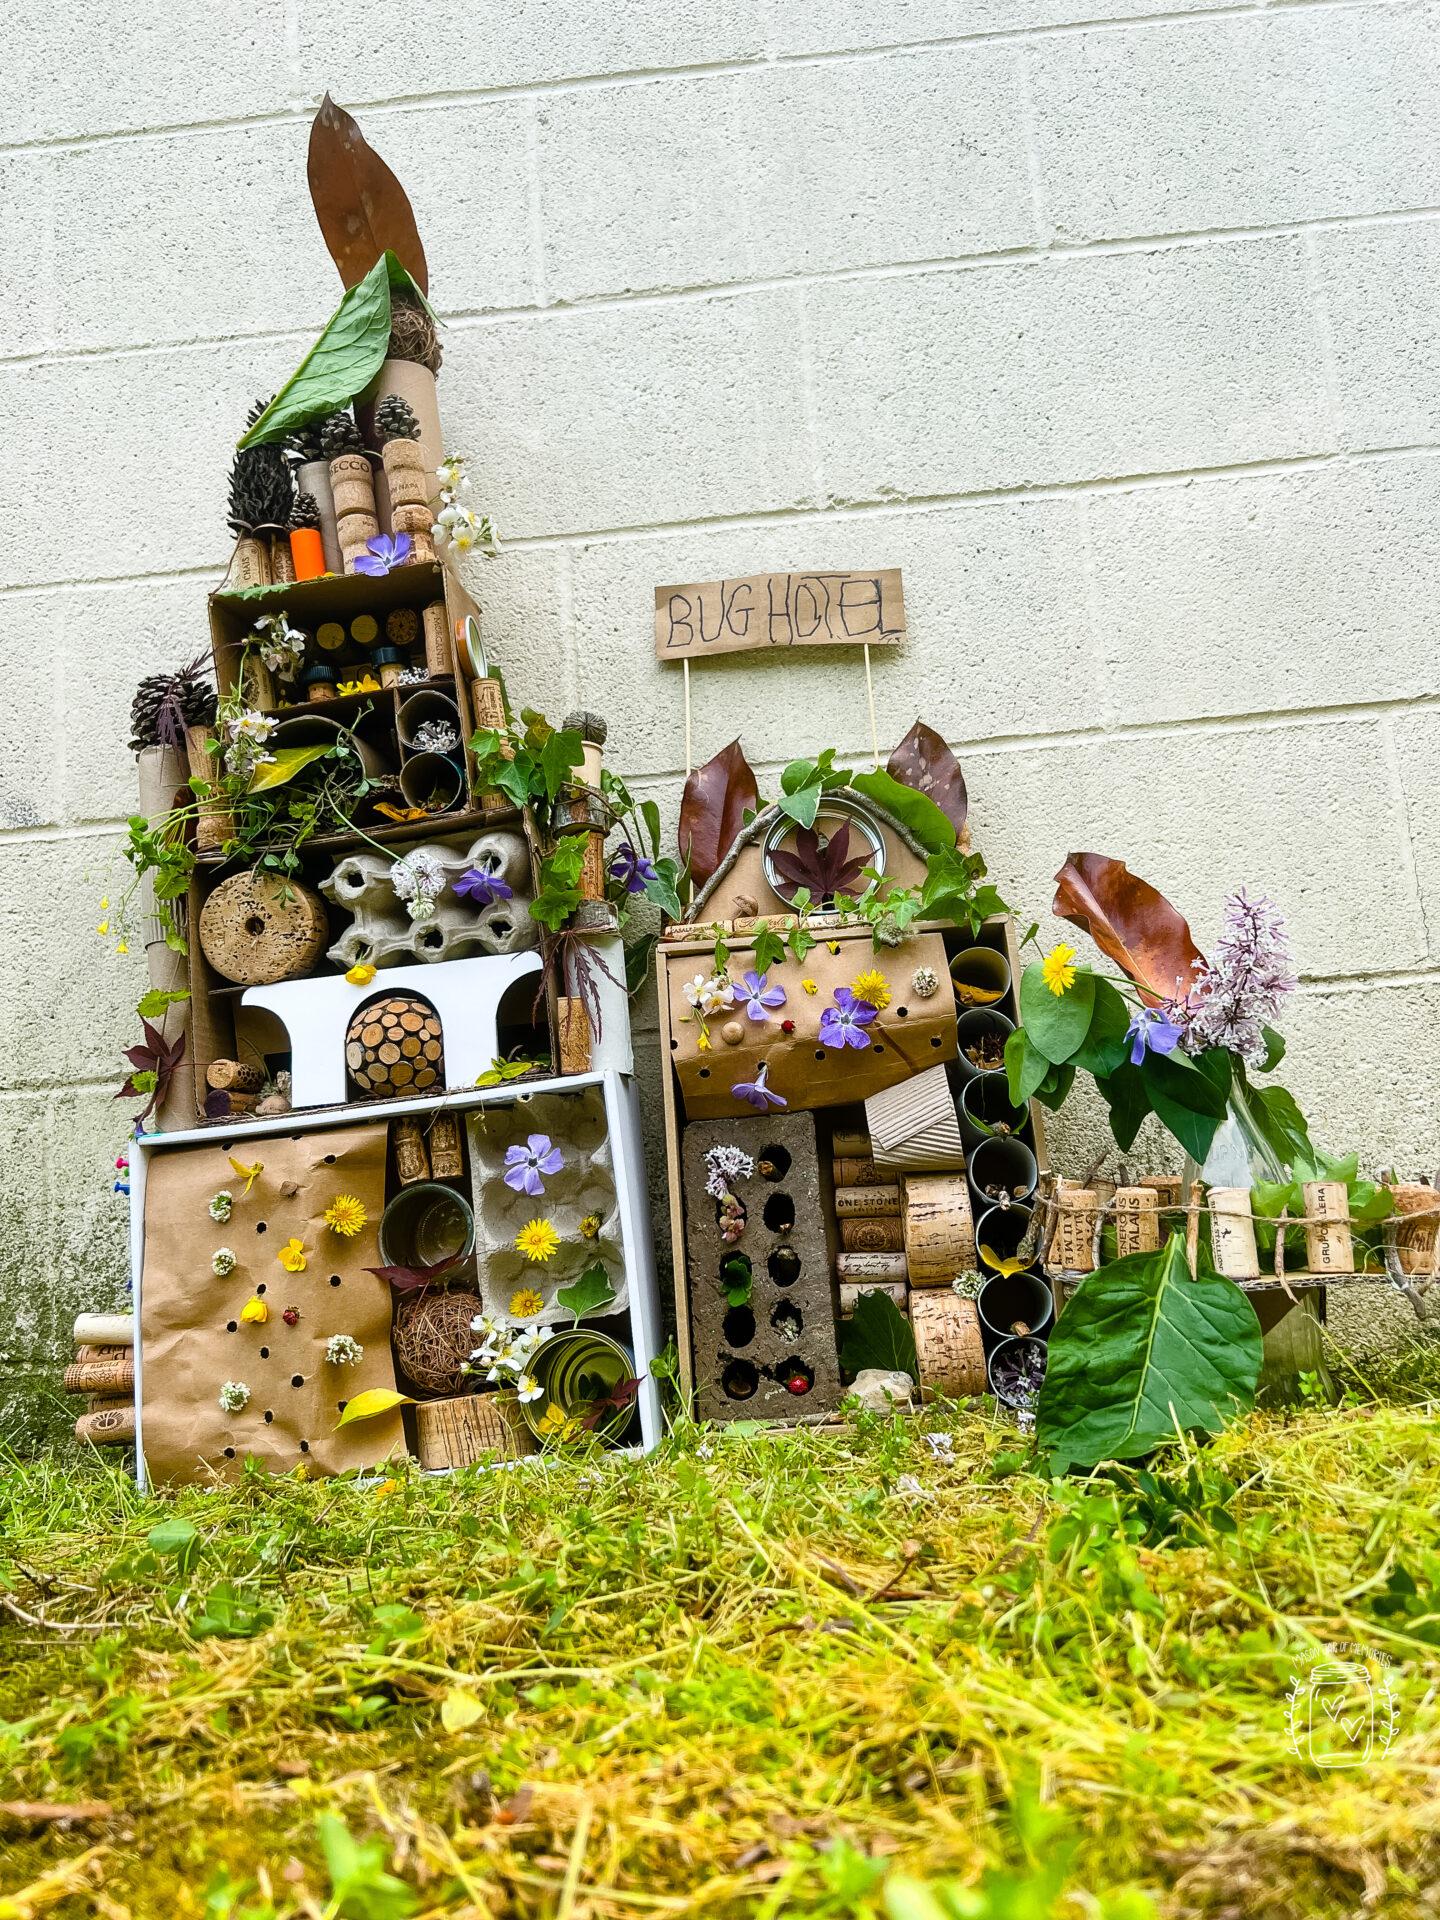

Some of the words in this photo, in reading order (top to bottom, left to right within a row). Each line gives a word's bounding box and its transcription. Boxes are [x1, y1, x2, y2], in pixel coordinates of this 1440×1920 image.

[242, 556, 251, 581] CHAIS
[666, 580, 754, 647] BUG
[768, 574, 906, 646] HOTEL
[838, 1199, 859, 1207] ONE
[864, 1197, 898, 1206] STONE
